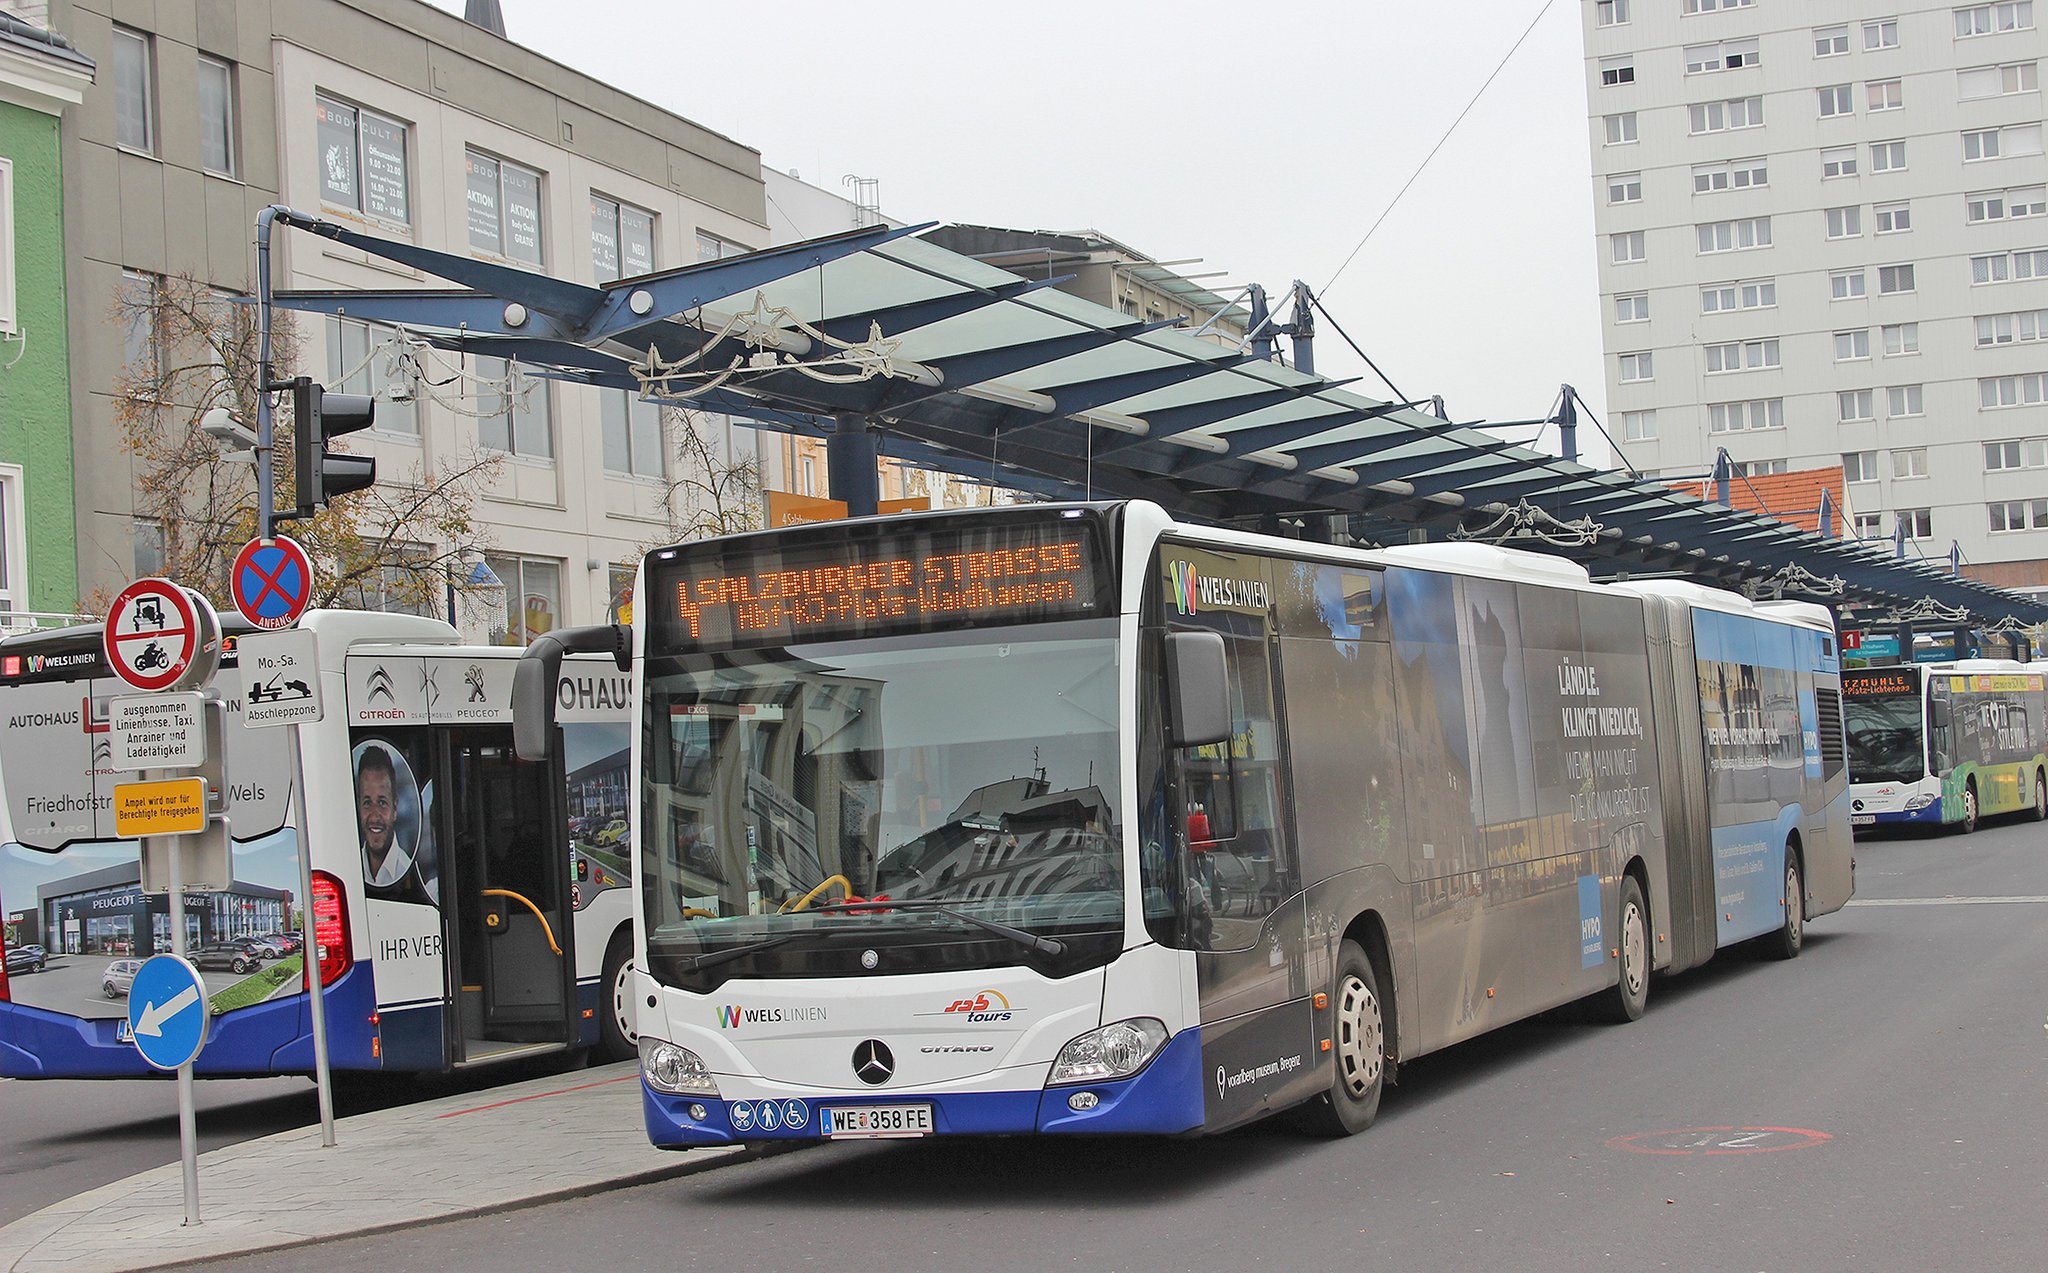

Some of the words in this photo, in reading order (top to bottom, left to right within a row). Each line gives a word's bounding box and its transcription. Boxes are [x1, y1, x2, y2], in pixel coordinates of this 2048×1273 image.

[327, 111, 357, 129] BODY
[473, 164, 499, 180] BODY
[467, 189, 494, 208] AKTION
[510, 203, 536, 221] AKTION
[700, 558, 913, 607] SALZBURGER
[922, 540, 1081, 586] STRASSE
[259, 613, 292, 630] ANFANG
[1970, 648, 1978, 659] 2
[258, 655, 297, 670] Mo.-Sa.
[1558, 657, 1600, 696] LÄNDLE.
[123, 702, 187, 718] ausgenommen
[248, 704, 316, 721] Abschleppzone
[457, 709, 500, 719] PEUGEOT
[9, 711, 79, 729] AUTOHAUS
[1562, 707, 1597, 738] KLINGT
[1599, 707, 1643, 740] NIEDLICH,
[127, 731, 166, 744] Anrainer
[127, 743, 187, 759] Ladetätigkeit
[1614, 748, 1638, 776] NICHT
[125, 797, 146, 809] Ampel
[148, 795, 164, 806] wird
[165, 795, 177, 805] nur
[119, 808, 158, 821] Berechtigte
[160, 805, 200, 819] freigegeben
[24, 824, 89, 836] CITARO
[93, 894, 136, 910] PEUGEOT
[1582, 916, 1601, 940] HYPO
[381, 938, 409, 960] IHR
[944, 994, 990, 1013] sab
[967, 1012, 1012, 1022] tours
[1227, 1068, 1255, 1088] vorarlberg
[1256, 1061, 1280, 1079] museum,
[1280, 1054, 1301, 1072] Bregenz
[833, 1111, 857, 1130] WE
[870, 1110, 902, 1129] 358
[906, 1110, 928, 1129] FE
